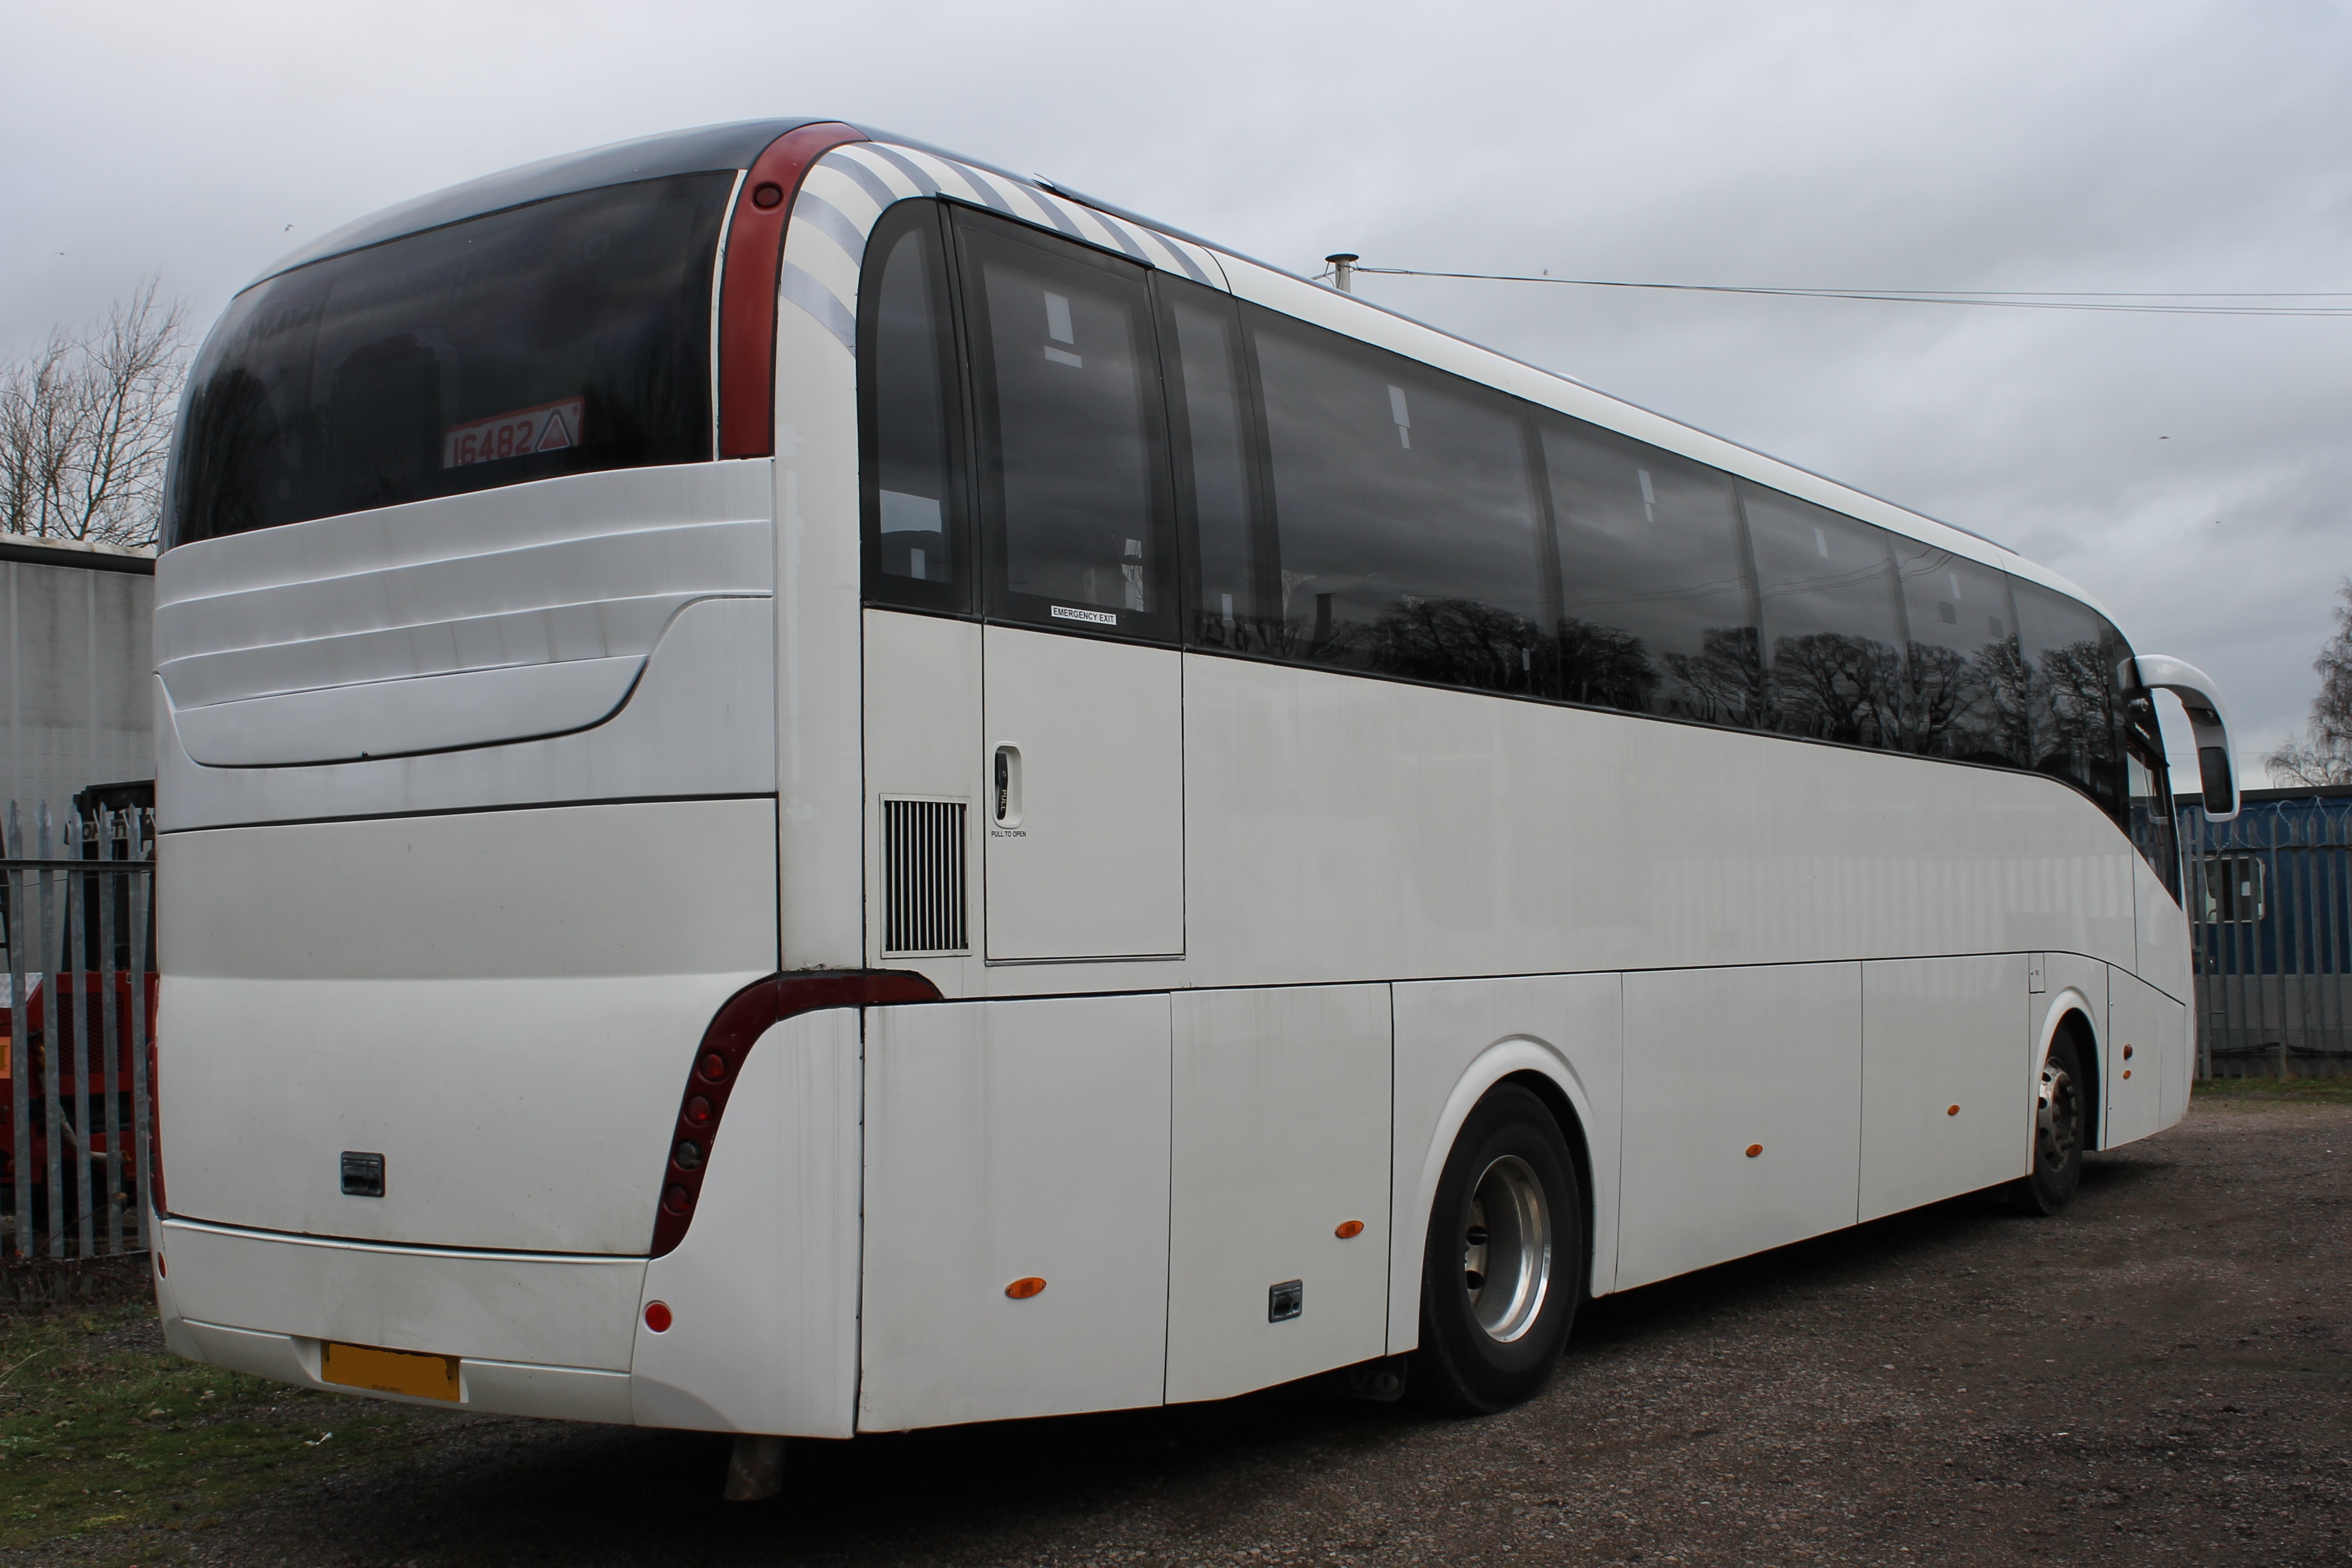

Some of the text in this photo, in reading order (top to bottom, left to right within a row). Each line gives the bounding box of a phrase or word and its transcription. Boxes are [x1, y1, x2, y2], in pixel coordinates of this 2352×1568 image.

[453, 420, 533, 467] 16482
[1053, 607, 1114, 623] EMERGENCY EXIT
